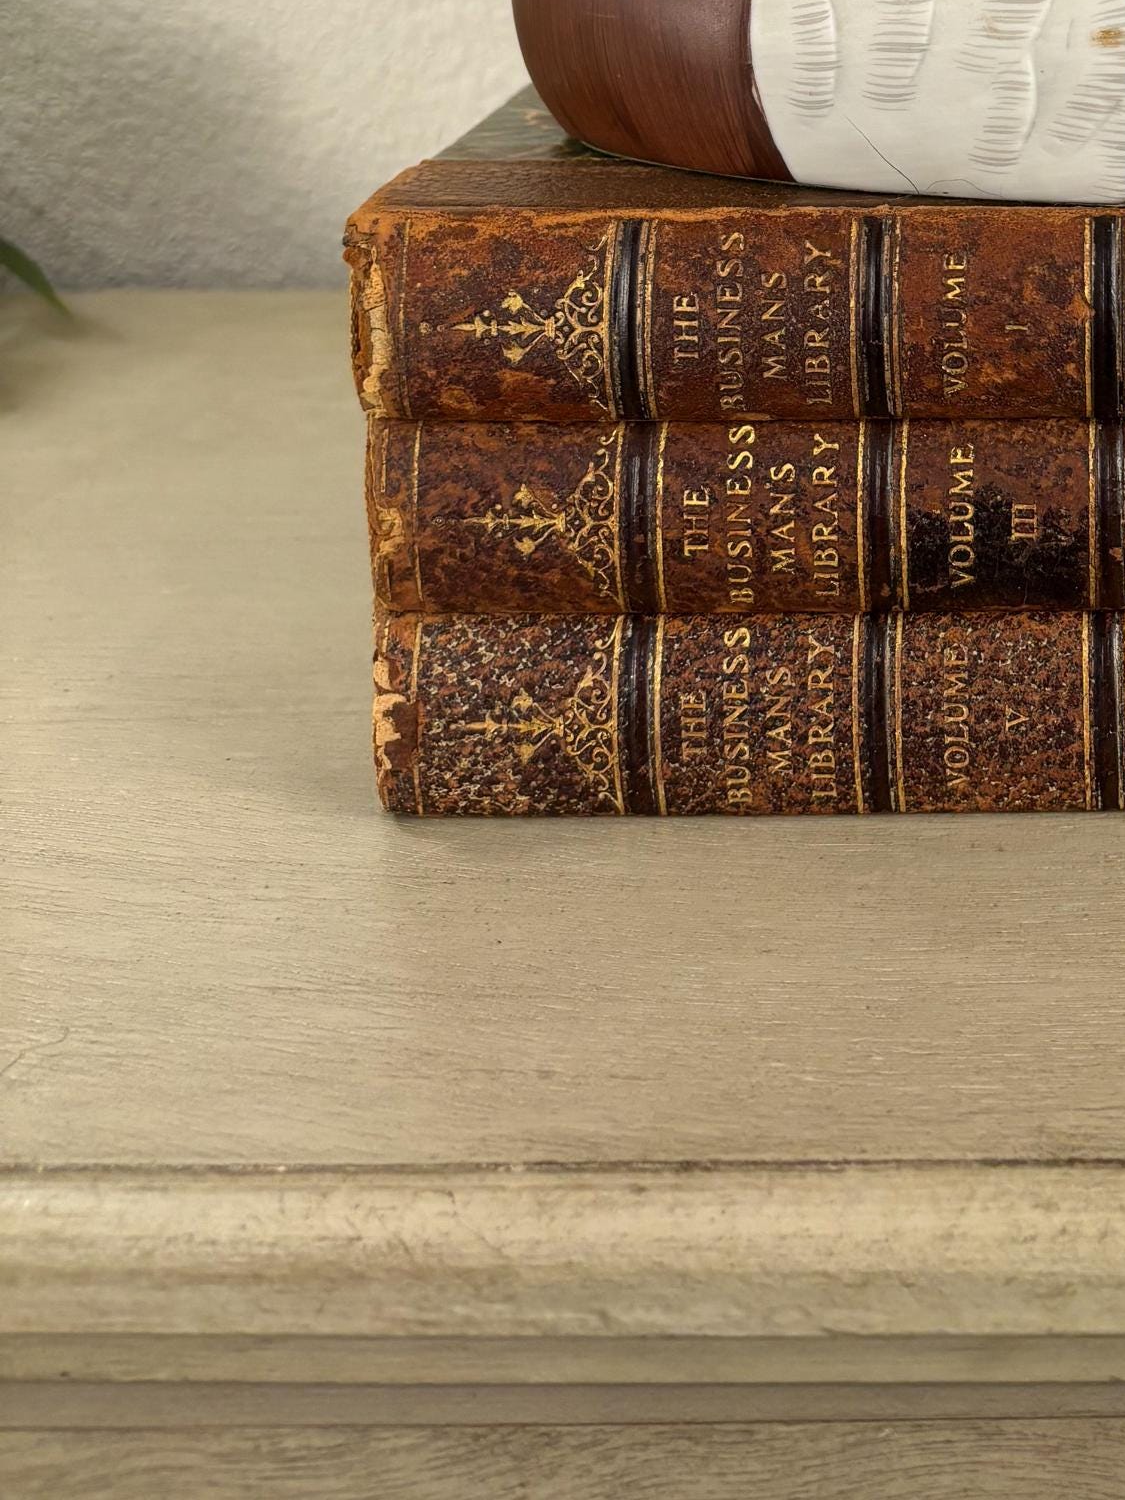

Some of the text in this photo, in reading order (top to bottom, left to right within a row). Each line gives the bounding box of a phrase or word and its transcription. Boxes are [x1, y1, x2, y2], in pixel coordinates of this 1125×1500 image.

[673, 293, 699, 364] THE
[717, 232, 745, 411] BUSINESS
[803, 240, 833, 405] LIBRARY
[941, 252, 968, 396] VOLUME
[683, 485, 710, 557] THE
[726, 425, 756, 604] BUSINESS
[812, 433, 840, 597] LIBRARY
[948, 442, 976, 589] VOLUME
[1010, 502, 1038, 542] III
[680, 690, 707, 761] THE
[723, 627, 752, 804] BUSINESS
[808, 630, 838, 798] LIBRARY
[943, 642, 970, 787] VOLUME
[1004, 705, 1029, 732] V
